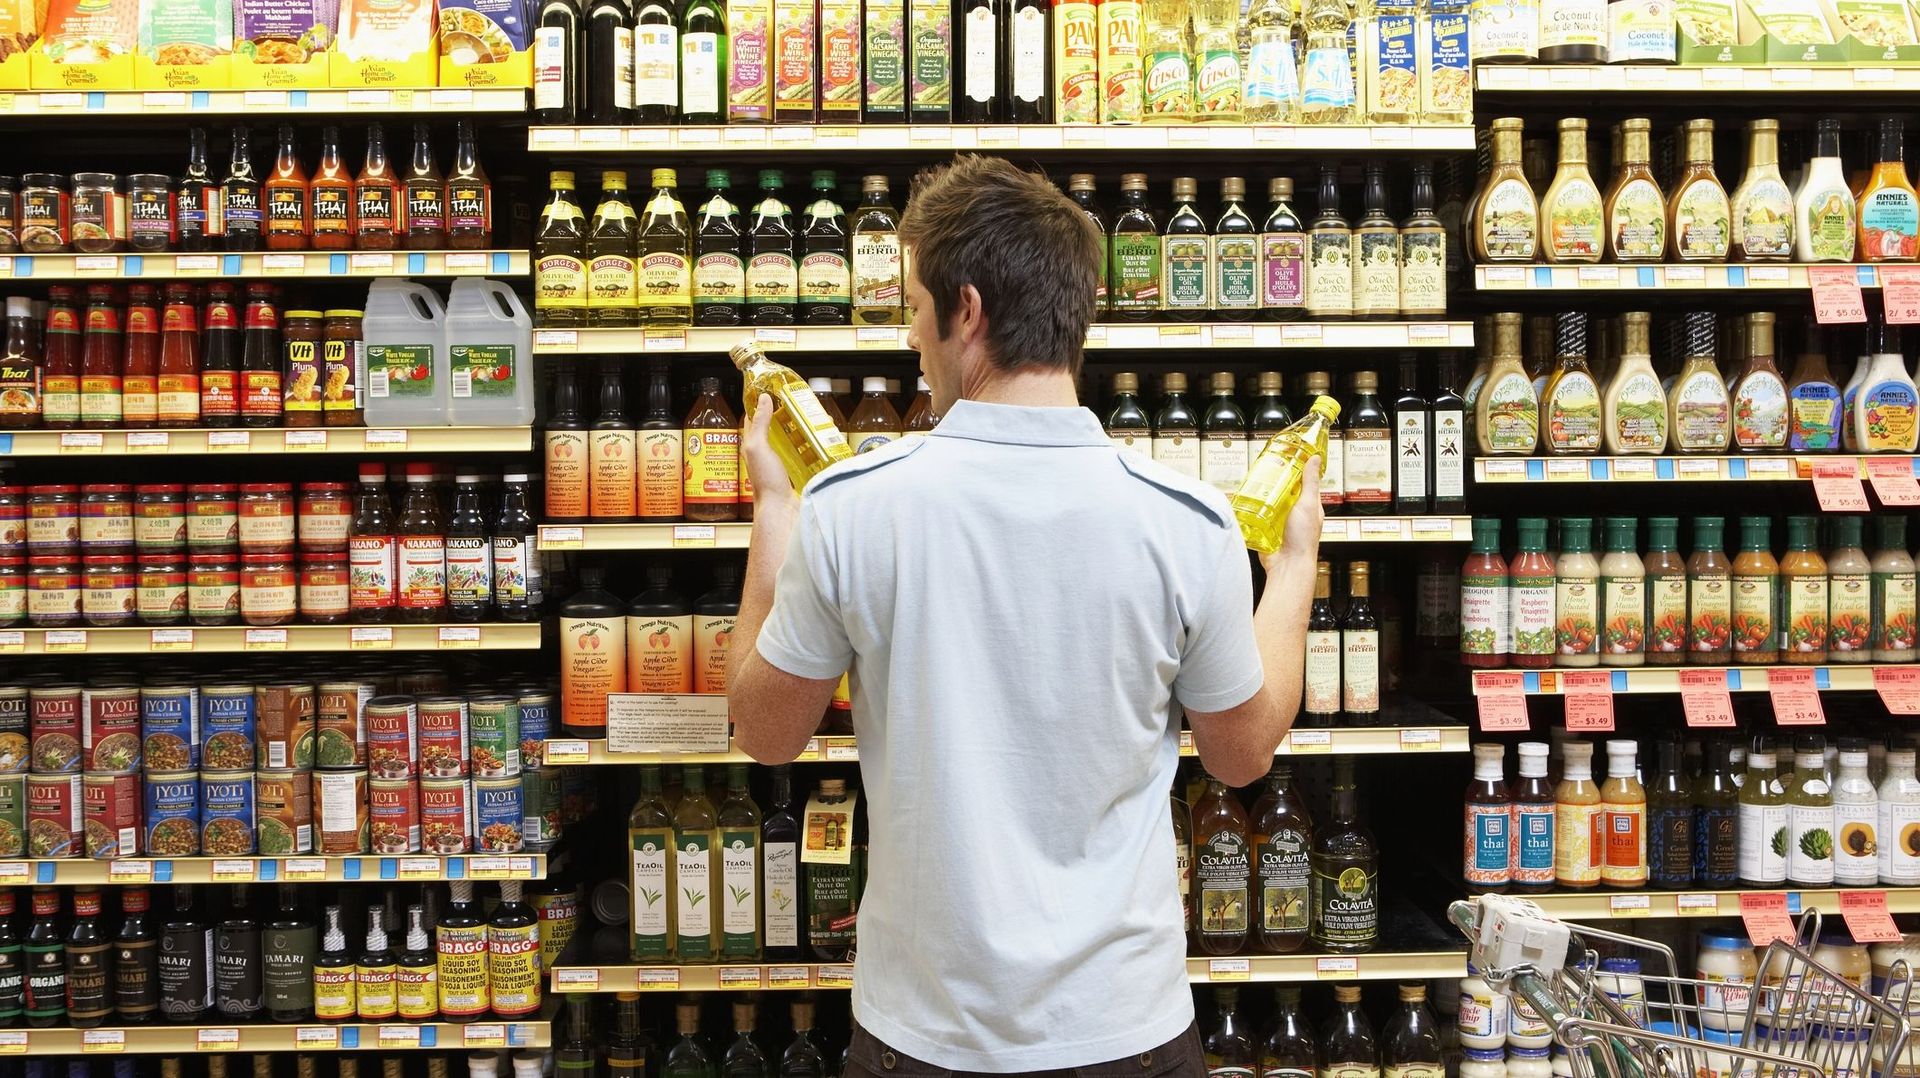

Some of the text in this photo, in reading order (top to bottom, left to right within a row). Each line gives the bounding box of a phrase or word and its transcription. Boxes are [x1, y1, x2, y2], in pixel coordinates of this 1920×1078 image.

[1553, 10, 1589, 22] Coconut
[1628, 30, 1663, 40] Coconut
[736, 45, 761, 53] WHITE
[739, 52, 759, 60] WINE
[1147, 66, 1185, 92] Crisco
[1198, 64, 1236, 91] Crisco
[230, 195, 256, 206] THAI
[133, 202, 165, 217] THAI
[270, 202, 301, 214] THAI
[316, 201, 346, 214] THAI
[358, 201, 389, 214] THAI
[410, 201, 441, 214] THAI
[451, 201, 483, 214] THAI
[541, 259, 577, 271] BORGES
[593, 259, 629, 271] BORGES
[644, 255, 681, 268] BORGES
[701, 255, 736, 268] BORGES
[755, 255, 790, 268] BORGES
[807, 255, 842, 267] BORGES
[1836, 309, 1862, 317] $5.00
[292, 362, 313, 371] Plum
[326, 362, 344, 370] Plum
[1, 367, 29, 379] Thai
[1353, 430, 1383, 439] Spectrum
[1349, 443, 1373, 452] Peanut
[407, 538, 442, 548] NAKANO
[1521, 598, 1549, 608] Raspberry
[1523, 616, 1546, 624] Dressing
[573, 657, 608, 666] Apple Cider
[643, 656, 678, 665] Apple Cider
[572, 665, 595, 673] Vinegar
[643, 664, 665, 672] Vinegar
[1483, 838, 1504, 848] thai
[1527, 838, 1549, 848] thai
[1612, 835, 1634, 846] thai
[1200, 854, 1248, 865] COLAVITA
[1262, 852, 1309, 864] COLAVITA
[1330, 898, 1373, 910] COLAVITA
[439, 941, 483, 954] BRAGG
[490, 940, 531, 954] BRAGG
[265, 955, 304, 964] TAMARI
[443, 966, 480, 974] SEASONING
[492, 966, 528, 974] SEASONING
[30, 975, 65, 988] ORGANI
[69, 977, 105, 989] TAMARI
[360, 974, 390, 983] BRAGG
[463, 981, 486, 989] LIQUIDE
[1532, 990, 1554, 1010] MARKET
